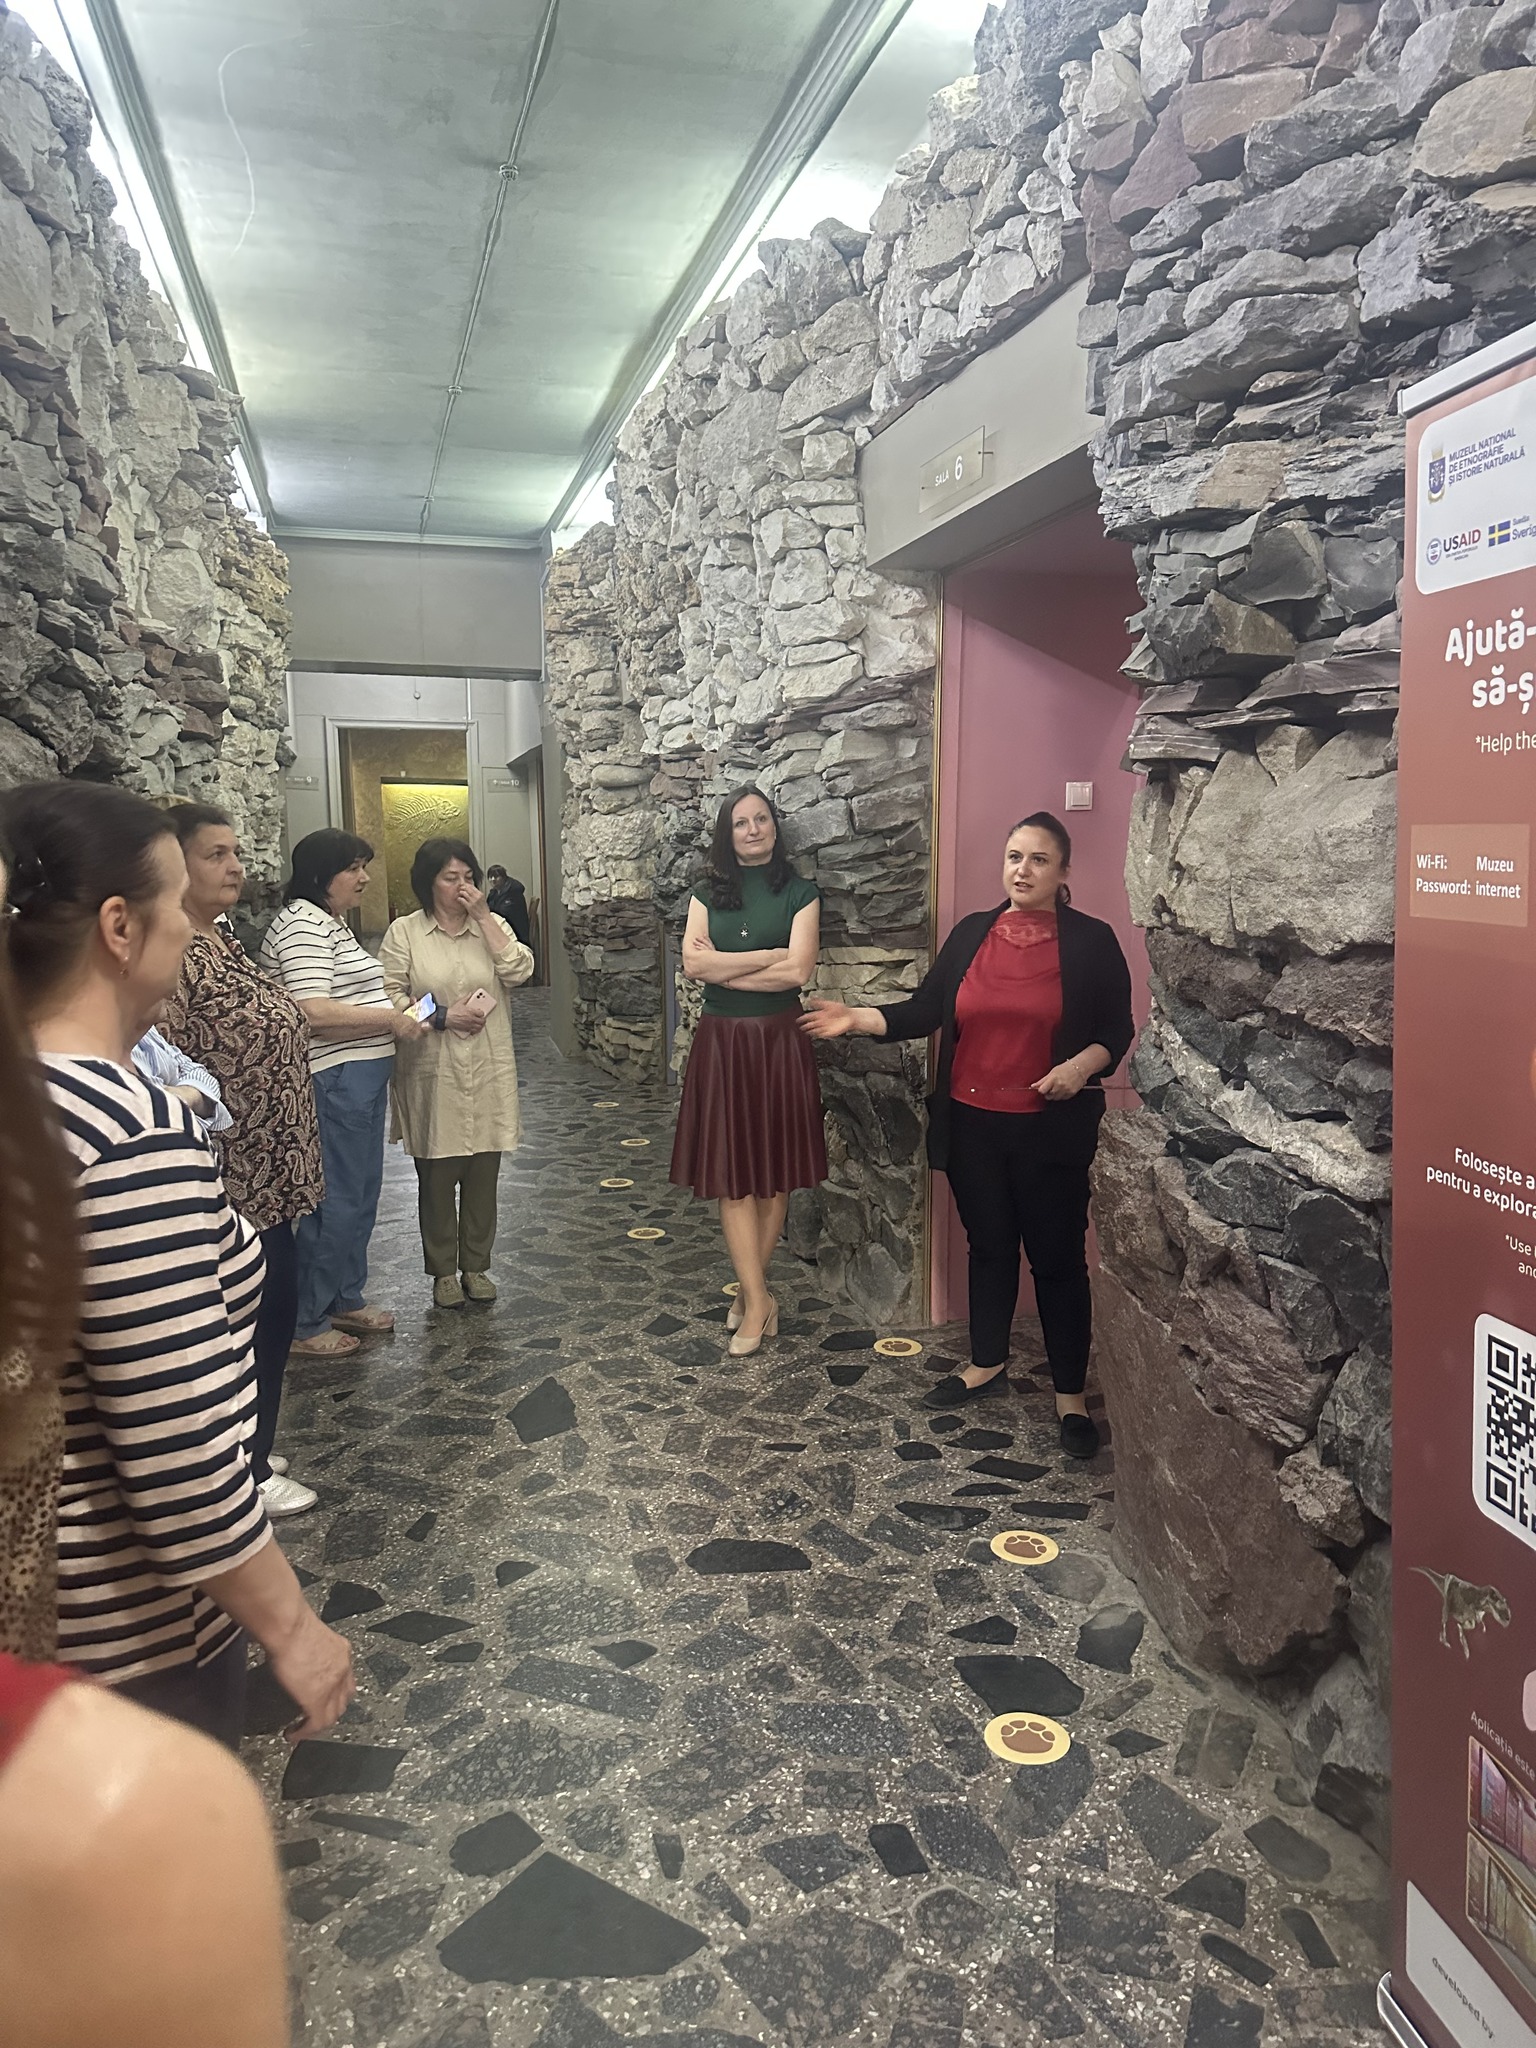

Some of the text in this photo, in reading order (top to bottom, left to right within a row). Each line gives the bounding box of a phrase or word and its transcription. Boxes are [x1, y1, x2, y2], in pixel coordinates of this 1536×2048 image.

[1448, 443, 1504, 474] DE ETNOGRAFIE
[1448, 445, 1526, 487] ȘI ISTORIE NATURALĂ
[1449, 444, 1478, 462] MUZEUL
[935, 455, 963, 487] SALA 6
[1443, 529, 1481, 552] USAID
[1445, 607, 1536, 667] Ajută-
[1416, 854, 1514, 872] Wi-Fi: Muzeu
[1416, 878, 1521, 899] Password: internet
[1426, 1166, 1471, 1194] pentru
[1473, 1184, 1481, 1198] a
[1455, 1147, 1522, 1186] Folosește
[1470, 1711, 1536, 1781] Aplicația este
[1432, 1957, 1480, 2021] developed
